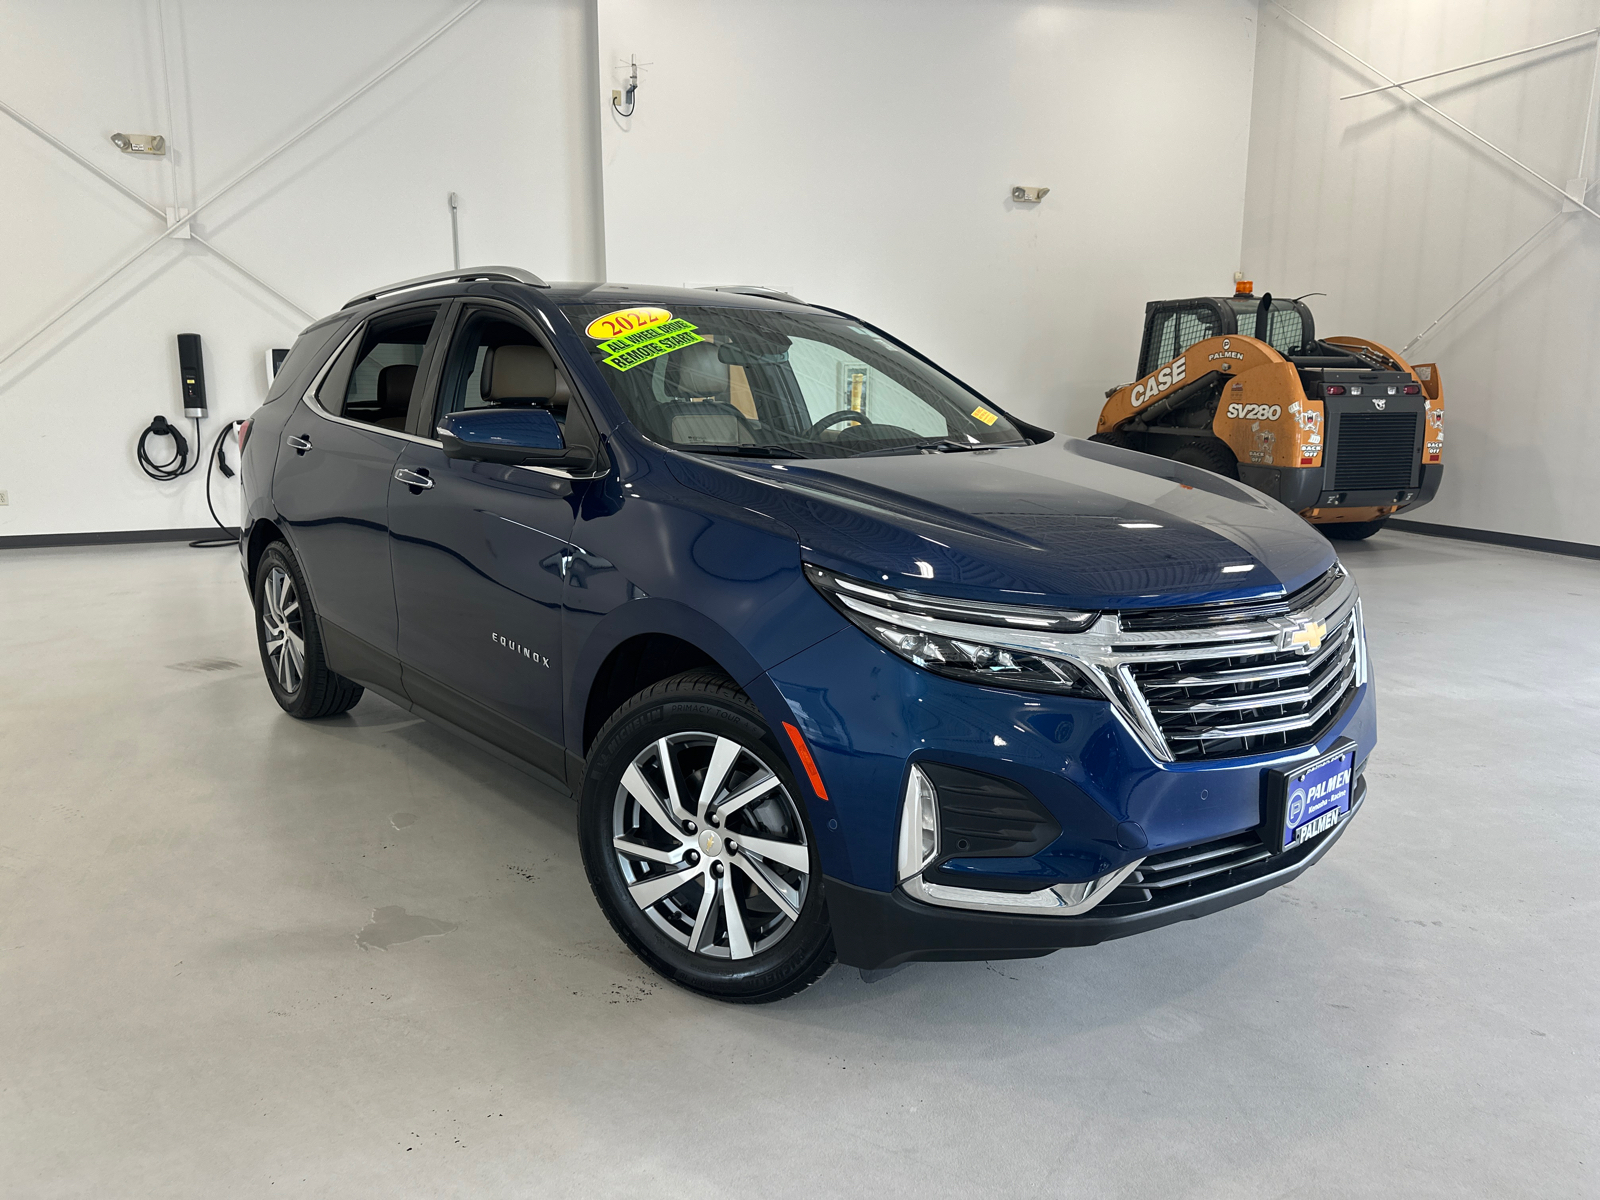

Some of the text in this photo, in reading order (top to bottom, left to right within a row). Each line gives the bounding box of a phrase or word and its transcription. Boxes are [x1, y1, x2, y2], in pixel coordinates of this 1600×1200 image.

[602, 310, 658, 336] 2022
[607, 320, 692, 353] ALL WHEEL DRIVE
[610, 331, 698, 369] REMOTE START
[1208, 351, 1243, 361] PALMEN
[1130, 356, 1186, 408] CASE
[1227, 403, 1282, 421] SV280
[492, 632, 550, 668] EQUINOX
[608, 707, 661, 754] MICHELIN
[672, 704, 712, 714] PRIMACY
[715, 708, 741, 725] TOUR
[1307, 767, 1351, 804] PALMEN
[1308, 798, 1328, 814] Kenosha
[1330, 789, 1346, 803] Racine
[1300, 808, 1338, 844] PALMEN
